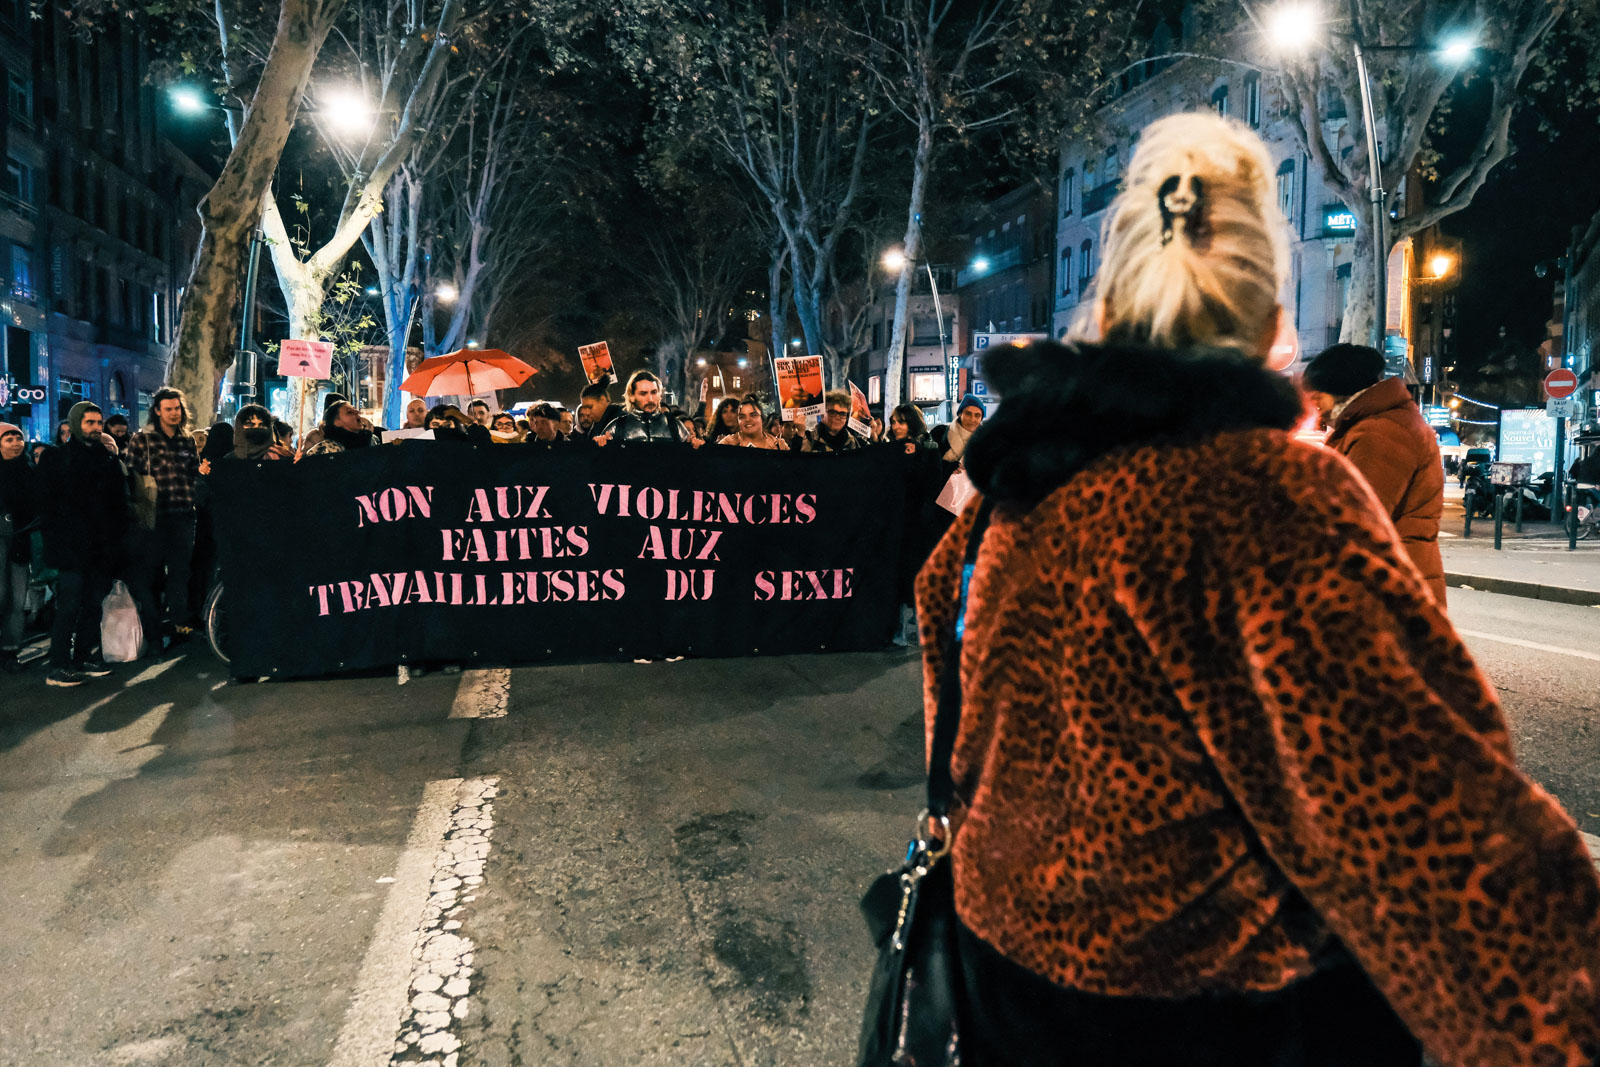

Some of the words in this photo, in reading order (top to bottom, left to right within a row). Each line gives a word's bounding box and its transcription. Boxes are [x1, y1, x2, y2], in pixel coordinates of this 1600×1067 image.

[1503, 432, 1535, 442] Nouvel
[1533, 435, 1553, 448] An
[355, 486, 433, 527] NON
[465, 486, 552, 522] AUX
[588, 484, 816, 524] VIOLENCES
[441, 526, 589, 561] FAITES
[638, 526, 722, 561] AUX
[309, 569, 625, 616] TRAVAILLEUSES
[665, 569, 715, 600] DU
[755, 568, 853, 600] SEXE
